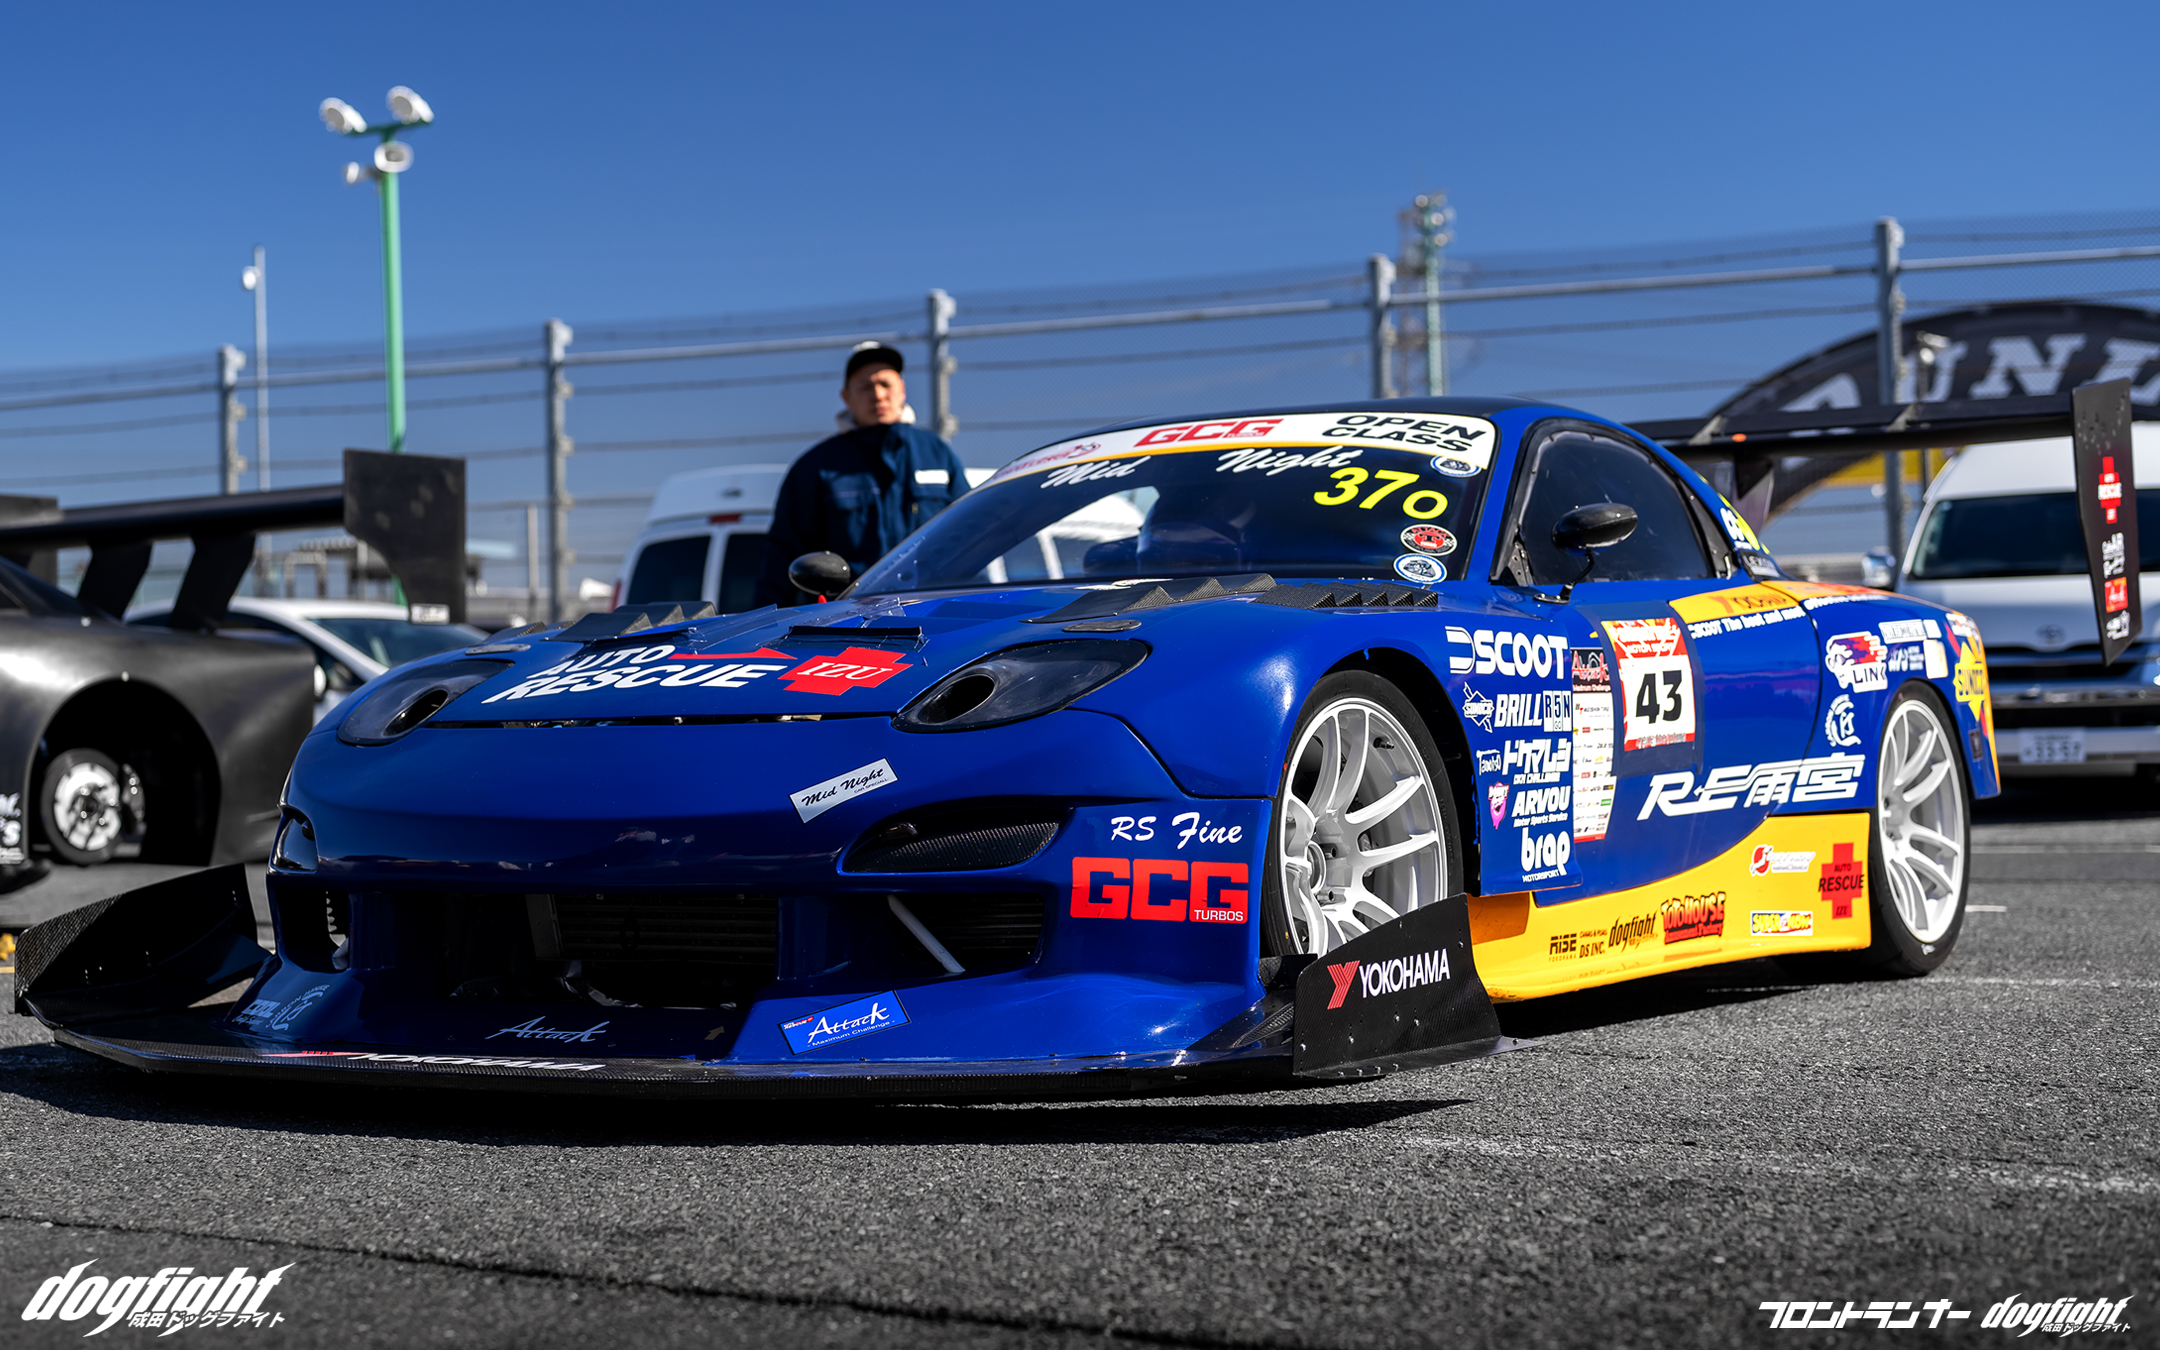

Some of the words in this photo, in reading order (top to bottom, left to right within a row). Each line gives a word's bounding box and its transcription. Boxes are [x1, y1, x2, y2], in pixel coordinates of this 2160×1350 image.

[1133, 418, 1285, 448] GCG
[1322, 427, 1472, 452] CLASS
[1337, 415, 1487, 440] OPEN
[1040, 455, 1151, 489] Mid
[1215, 445, 1364, 477] Night
[526, 644, 678, 679] AUTO
[796, 662, 893, 680] IZU
[481, 664, 789, 704] RESCUE
[1635, 670, 1682, 724] 43
[1494, 693, 1543, 727] BRILL
[801, 786, 837, 806] Mid
[840, 768, 883, 790] Night
[1511, 785, 1571, 817] ARVOU
[1111, 816, 1157, 841] RS
[1172, 812, 1243, 850] Fine
[1521, 827, 1571, 877] brap
[1070, 857, 1249, 924] GCG
[1818, 874, 1865, 892] RESCUE
[1194, 909, 1244, 922] TURBOS
[1608, 909, 1658, 954] dogfight
[1579, 943, 1590, 958] DS
[1359, 948, 1450, 998] YOKOHAMA
[485, 1016, 610, 1043] Attack
[808, 1002, 890, 1044] Attack
[812, 1032, 850, 1047] Maximum
[852, 1021, 890, 1035] Challenge
